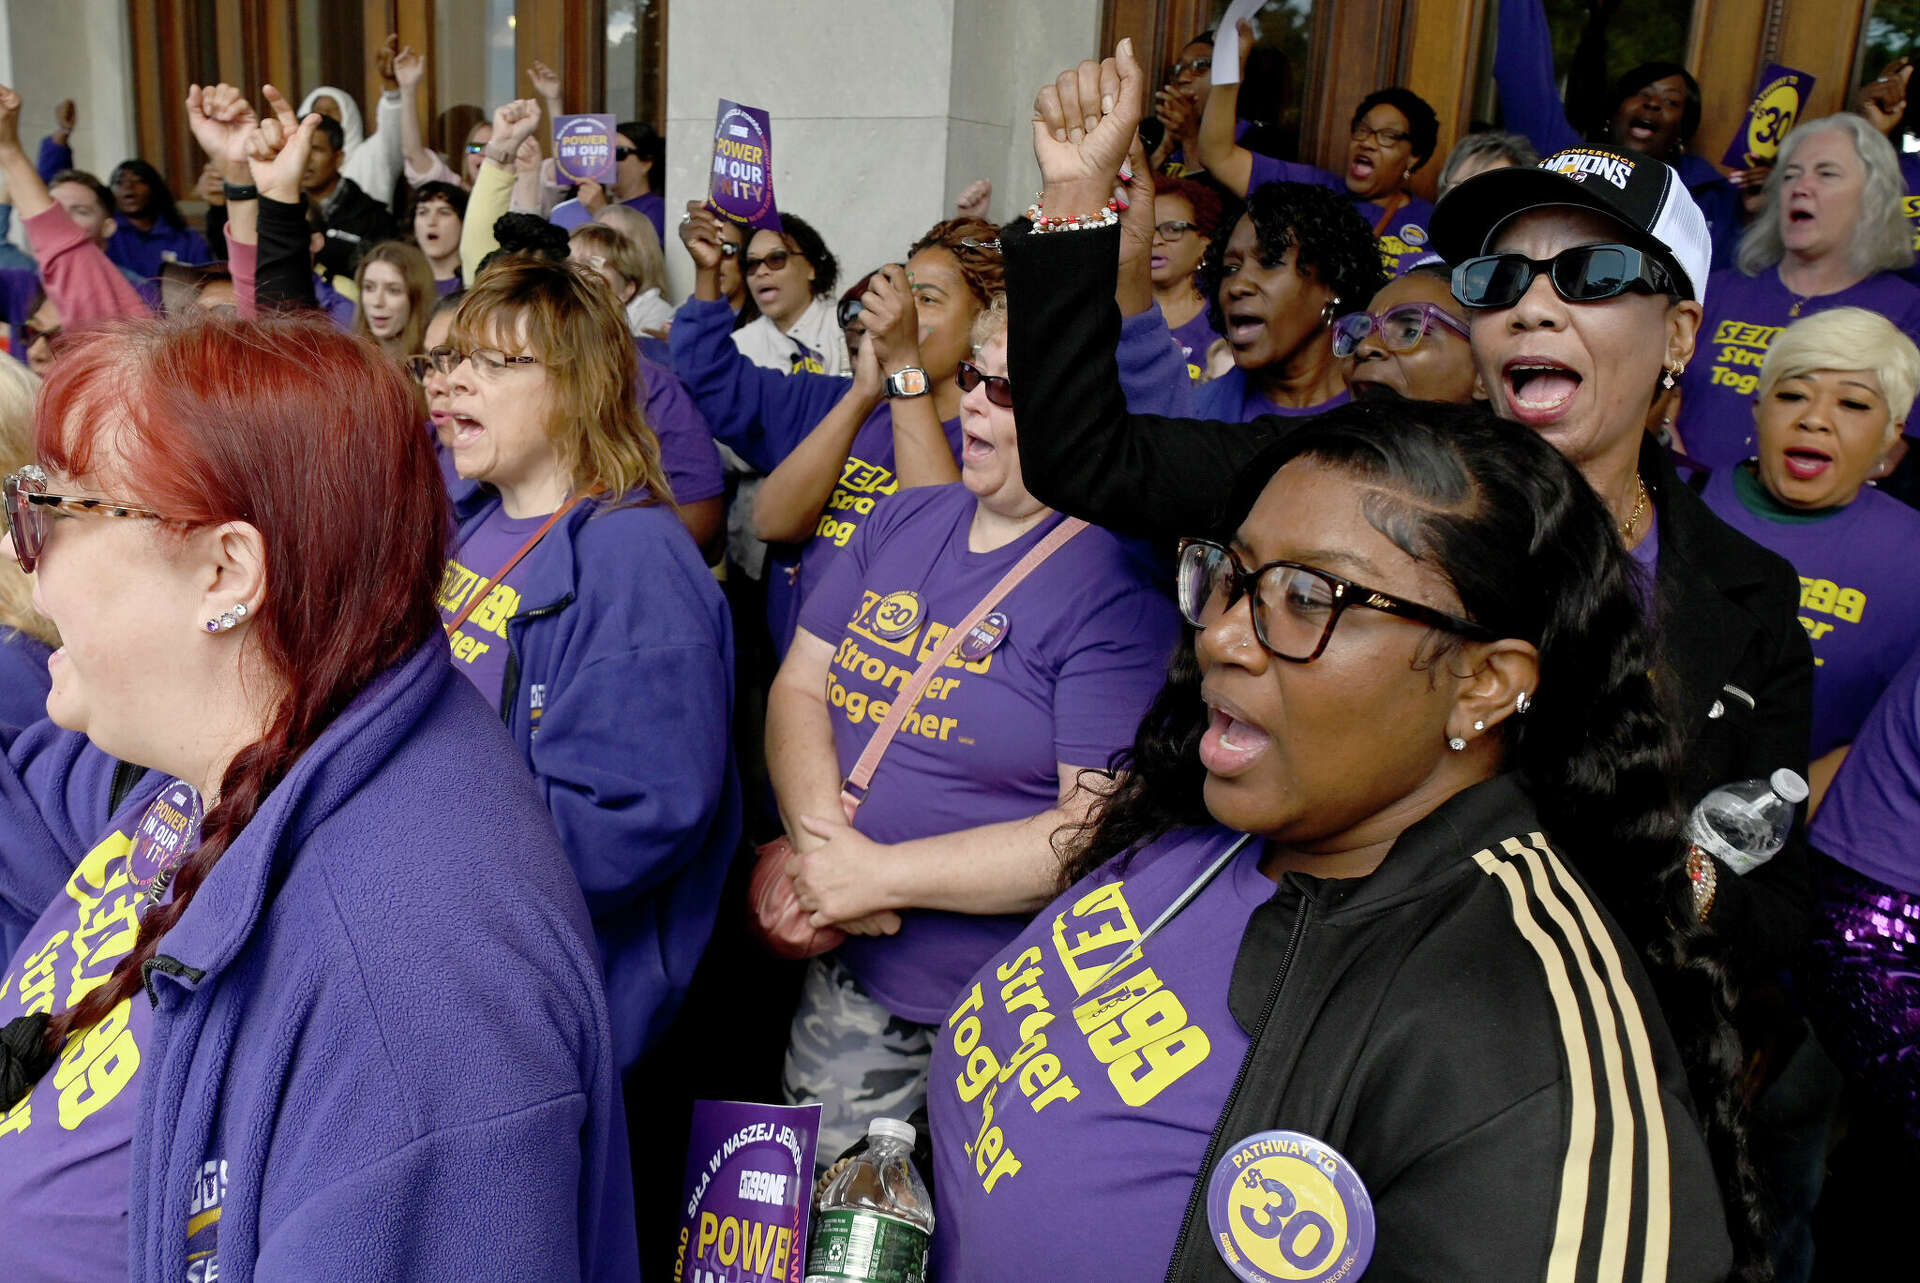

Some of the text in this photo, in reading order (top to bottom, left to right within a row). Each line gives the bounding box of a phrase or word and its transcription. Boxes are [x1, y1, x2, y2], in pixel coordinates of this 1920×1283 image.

[561, 145, 608, 157] IN OUR
[563, 135, 608, 145] POWER
[717, 138, 763, 164] POWER
[714, 156, 763, 184] IN OUR
[1552, 148, 1637, 169] CONFERENCE
[721, 179, 763, 202] NITY
[1712, 320, 1786, 350] SEI
[834, 637, 961, 706] Stroner
[826, 671, 959, 741] Togeher
[153, 799, 189, 834] POWER
[143, 815, 178, 852] IN OUR
[688, 1172, 711, 1220] SIŁA
[709, 1150, 722, 1174] W
[723, 1123, 776, 1159] NASZEJ
[1231, 1139, 1338, 1173] PATHWAY TO
[1240, 1167, 1335, 1271] $30
